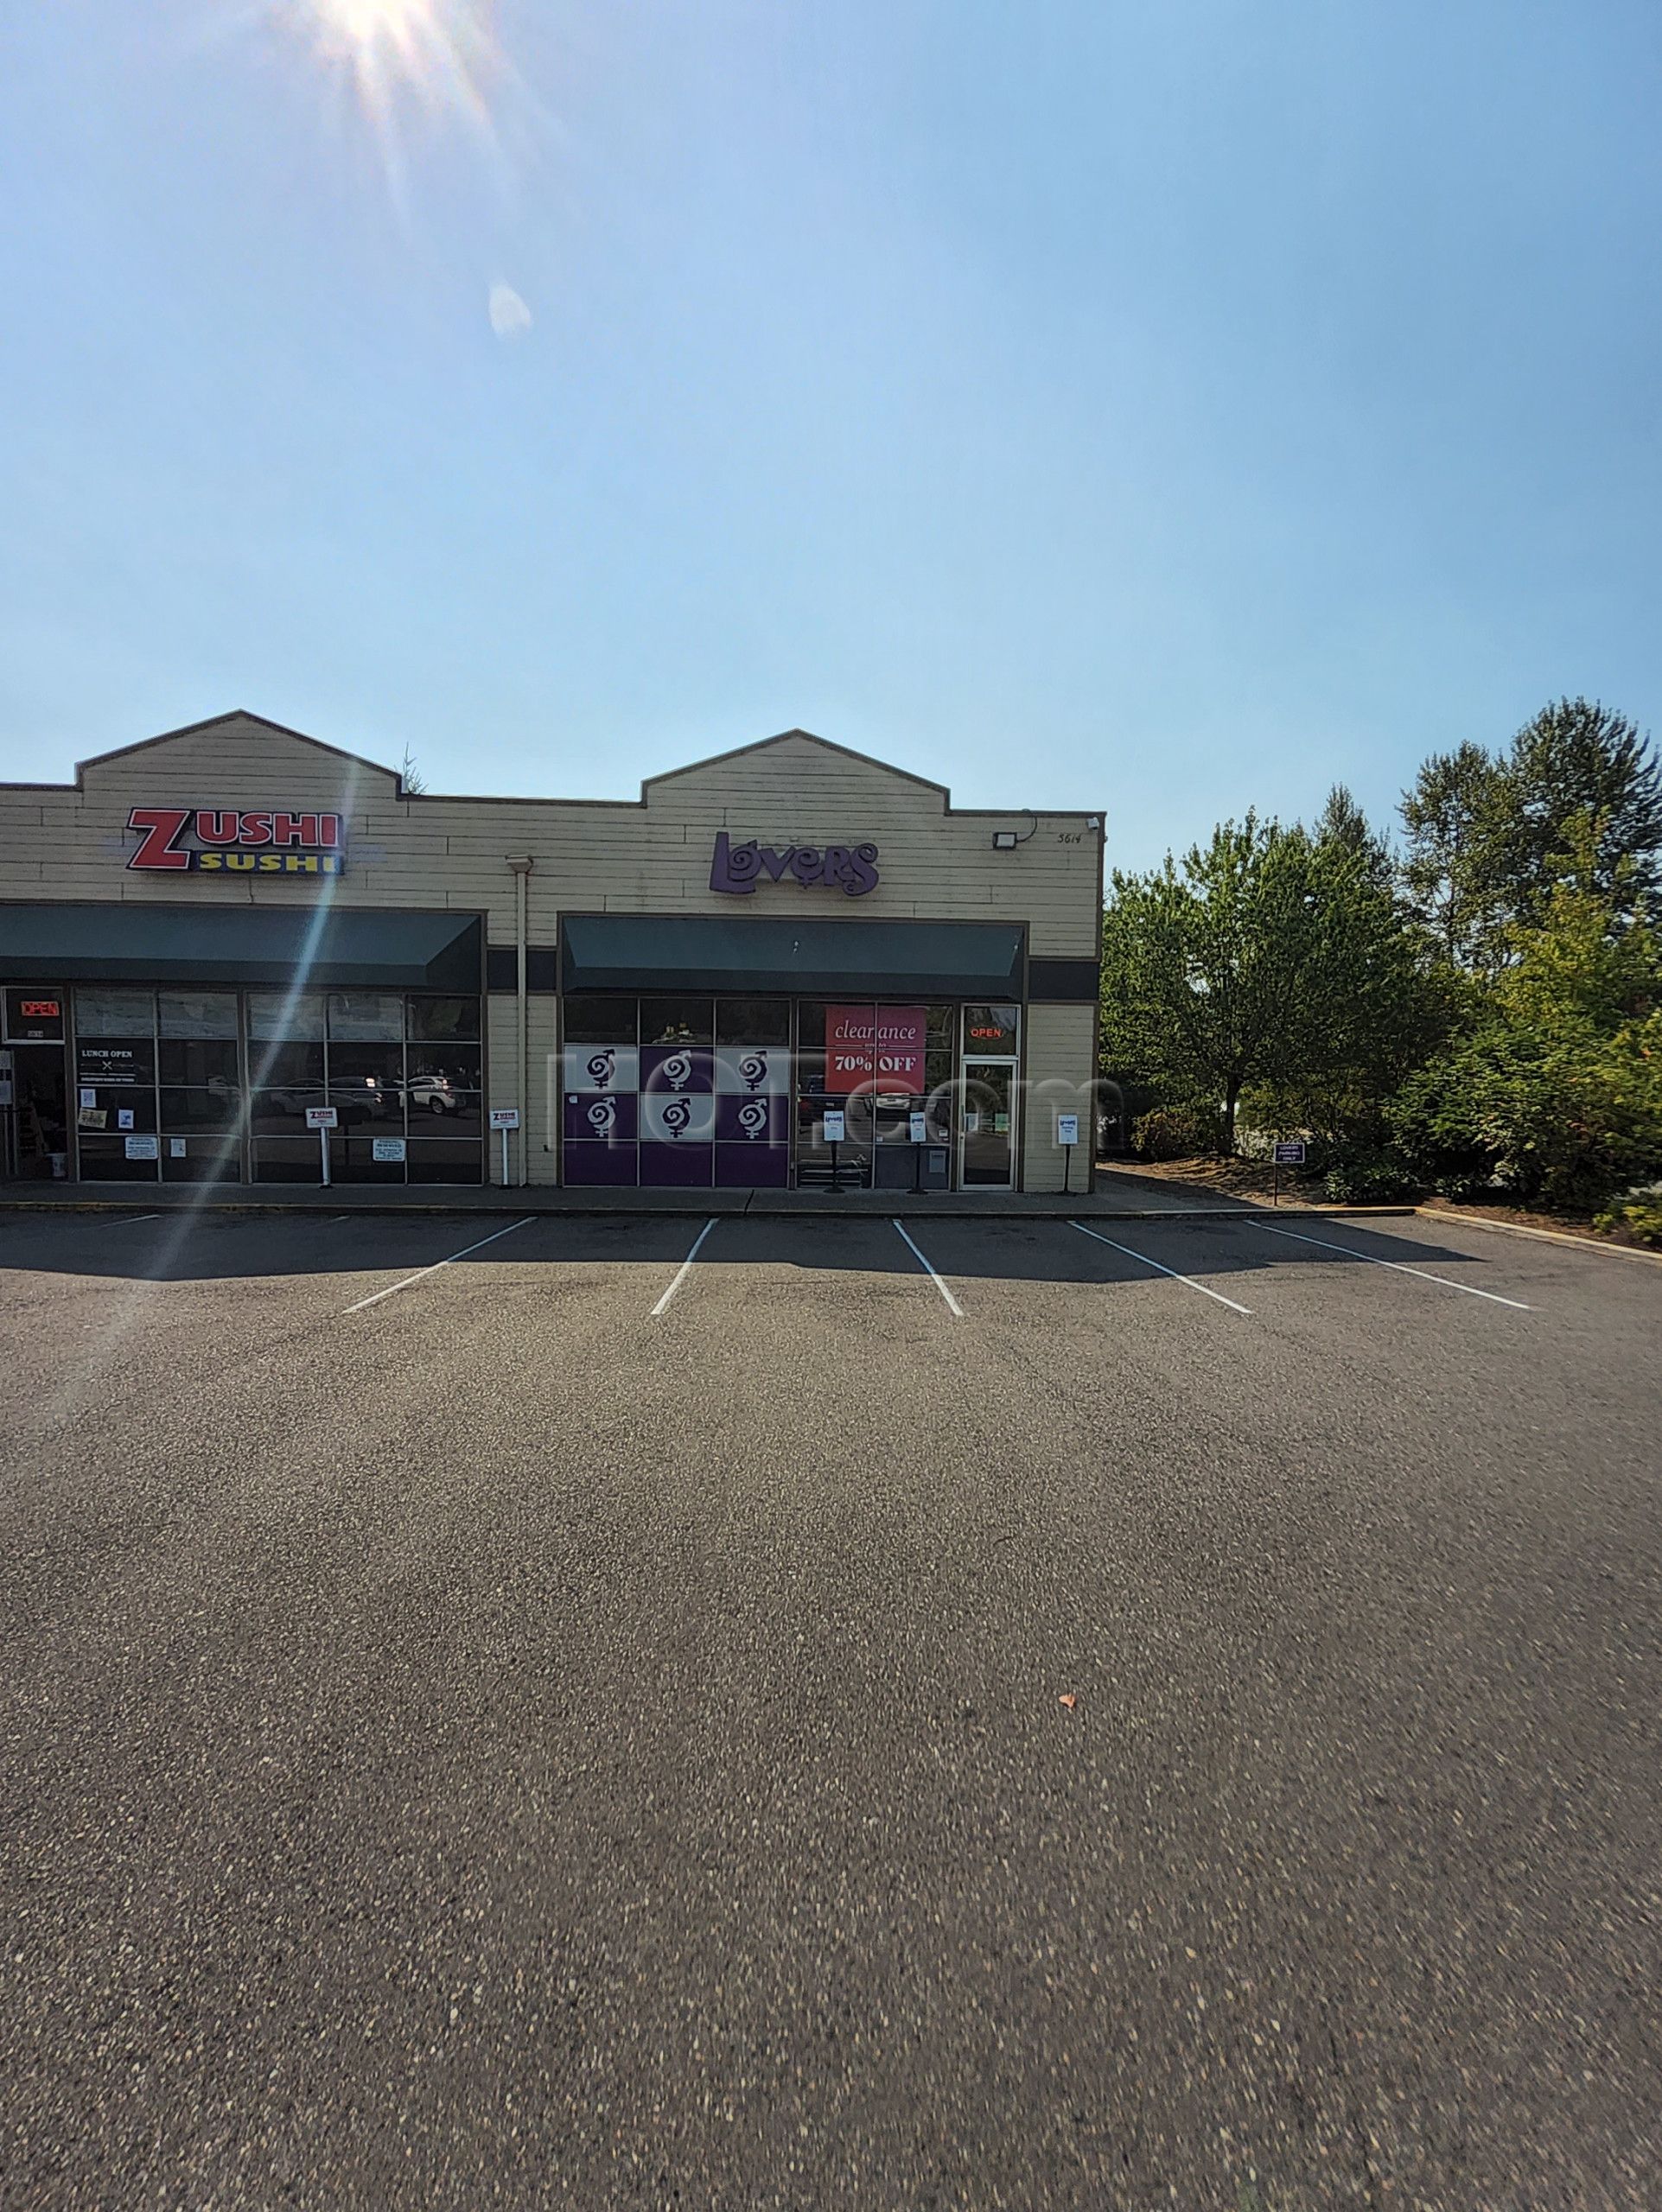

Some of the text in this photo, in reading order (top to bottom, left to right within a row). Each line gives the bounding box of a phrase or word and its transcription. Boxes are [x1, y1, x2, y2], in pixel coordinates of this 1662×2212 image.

[129, 808, 340, 869] ZUSHI
[1057, 833, 1081, 843] 5614
[200, 853, 337, 872] SUSHI
[24, 1003, 57, 1014] OPEN
[835, 1020, 916, 1039] clearance
[971, 1028, 1002, 1037] OPEN
[835, 1056, 917, 1071] 70% OFF
